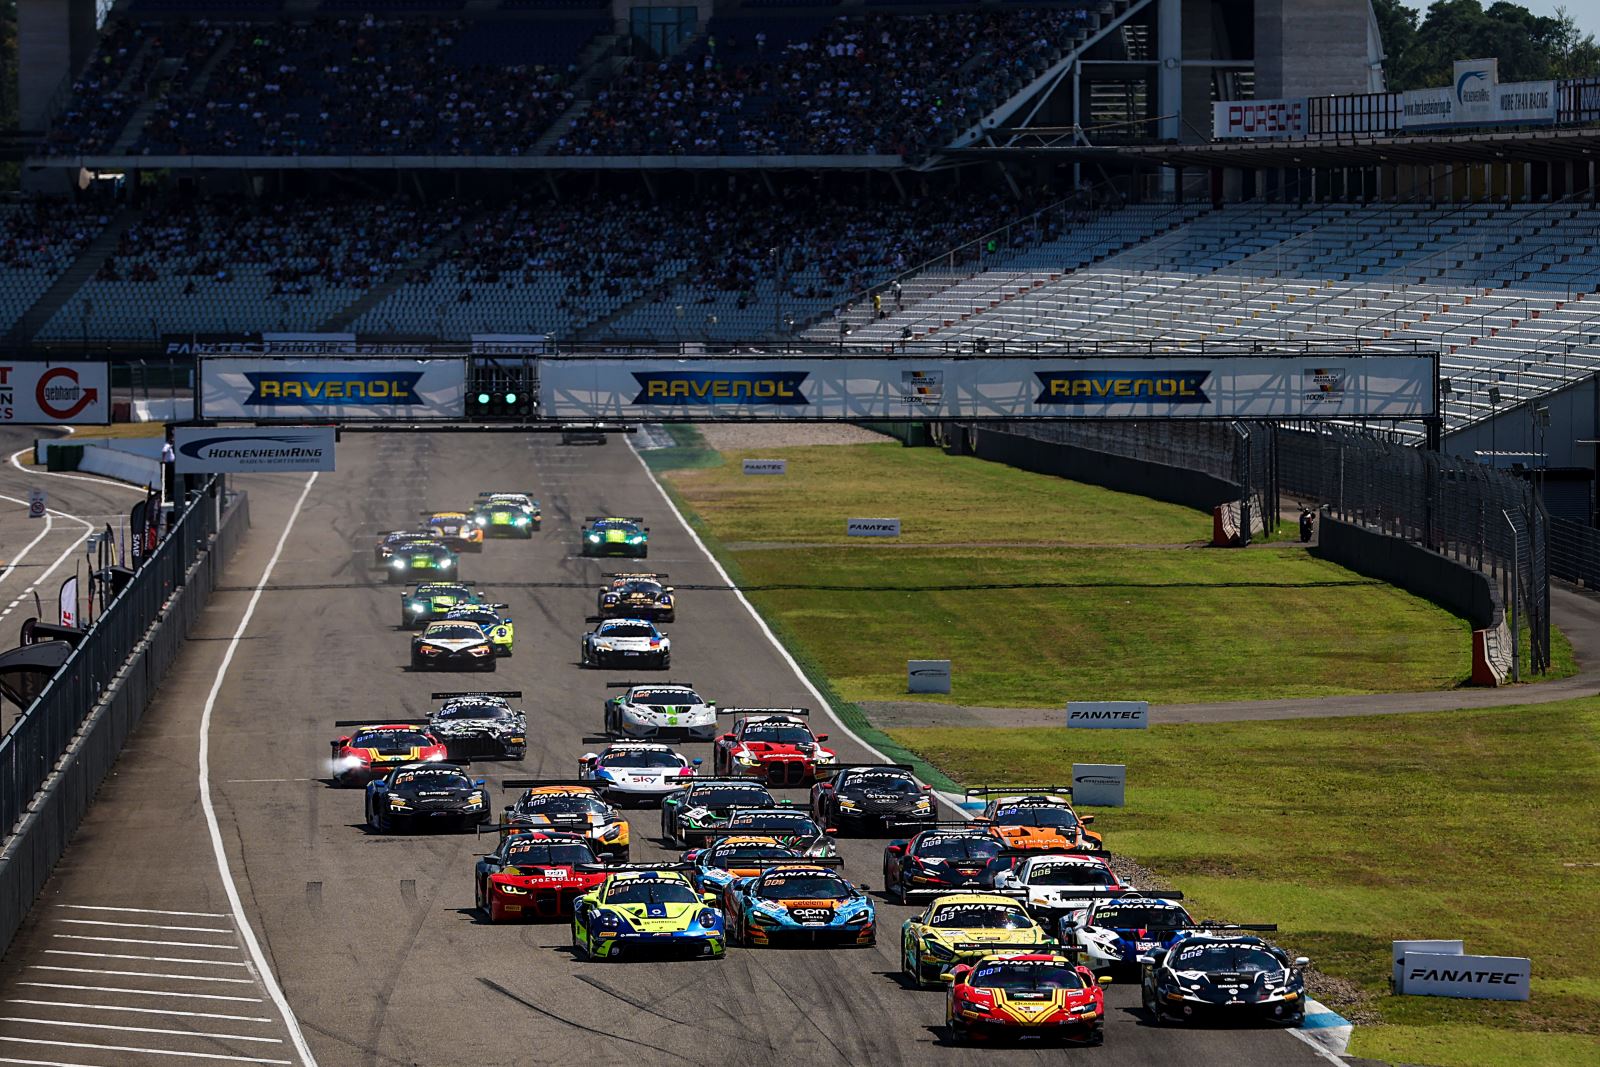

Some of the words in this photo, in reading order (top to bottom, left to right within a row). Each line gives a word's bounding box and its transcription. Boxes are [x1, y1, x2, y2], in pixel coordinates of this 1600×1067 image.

[1229, 104, 1301, 132] PORSCHE
[259, 380, 409, 398] RAVENOL
[647, 380, 794, 398] RAVENOL
[1050, 378, 1195, 397] RAVENOL
[207, 448, 323, 459] HOCKENHEIMRING
[132, 533, 141, 557] aws
[1070, 711, 1142, 720] FANATEC
[397, 770, 463, 778] FANATEC
[847, 772, 911, 780] FANATEC
[632, 776, 657, 784] sky
[530, 792, 598, 801] FANATEC
[511, 838, 584, 847] FANATEC
[1032, 862, 1108, 870] FANATEC
[764, 872, 838, 880] FANATEC
[612, 878, 688, 888] FANATEC
[793, 908, 830, 917] apm
[940, 904, 1020, 914] FANATEC
[1182, 943, 1266, 953] FANATEC
[1409, 969, 1522, 985] FANATEC
